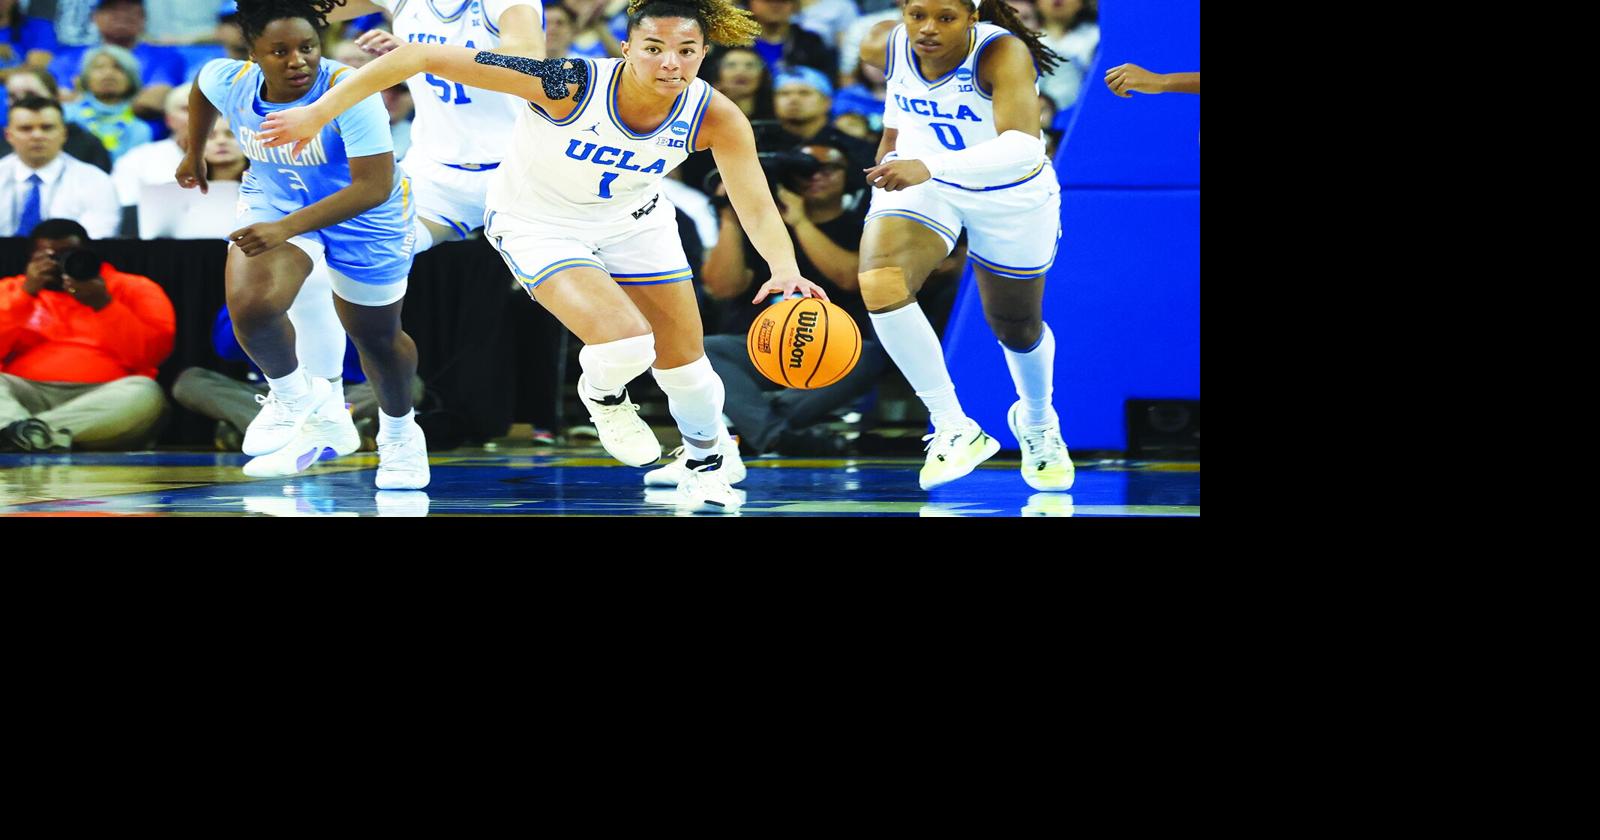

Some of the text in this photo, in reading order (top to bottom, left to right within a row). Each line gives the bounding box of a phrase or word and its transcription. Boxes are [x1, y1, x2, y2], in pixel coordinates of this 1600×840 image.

[894, 94, 982, 122] UCLA
[928, 122, 967, 151] 0
[565, 138, 667, 174] UCLA
[277, 168, 309, 193] 3
[596, 171, 620, 199] 1
[789, 311, 819, 369] Wilson
